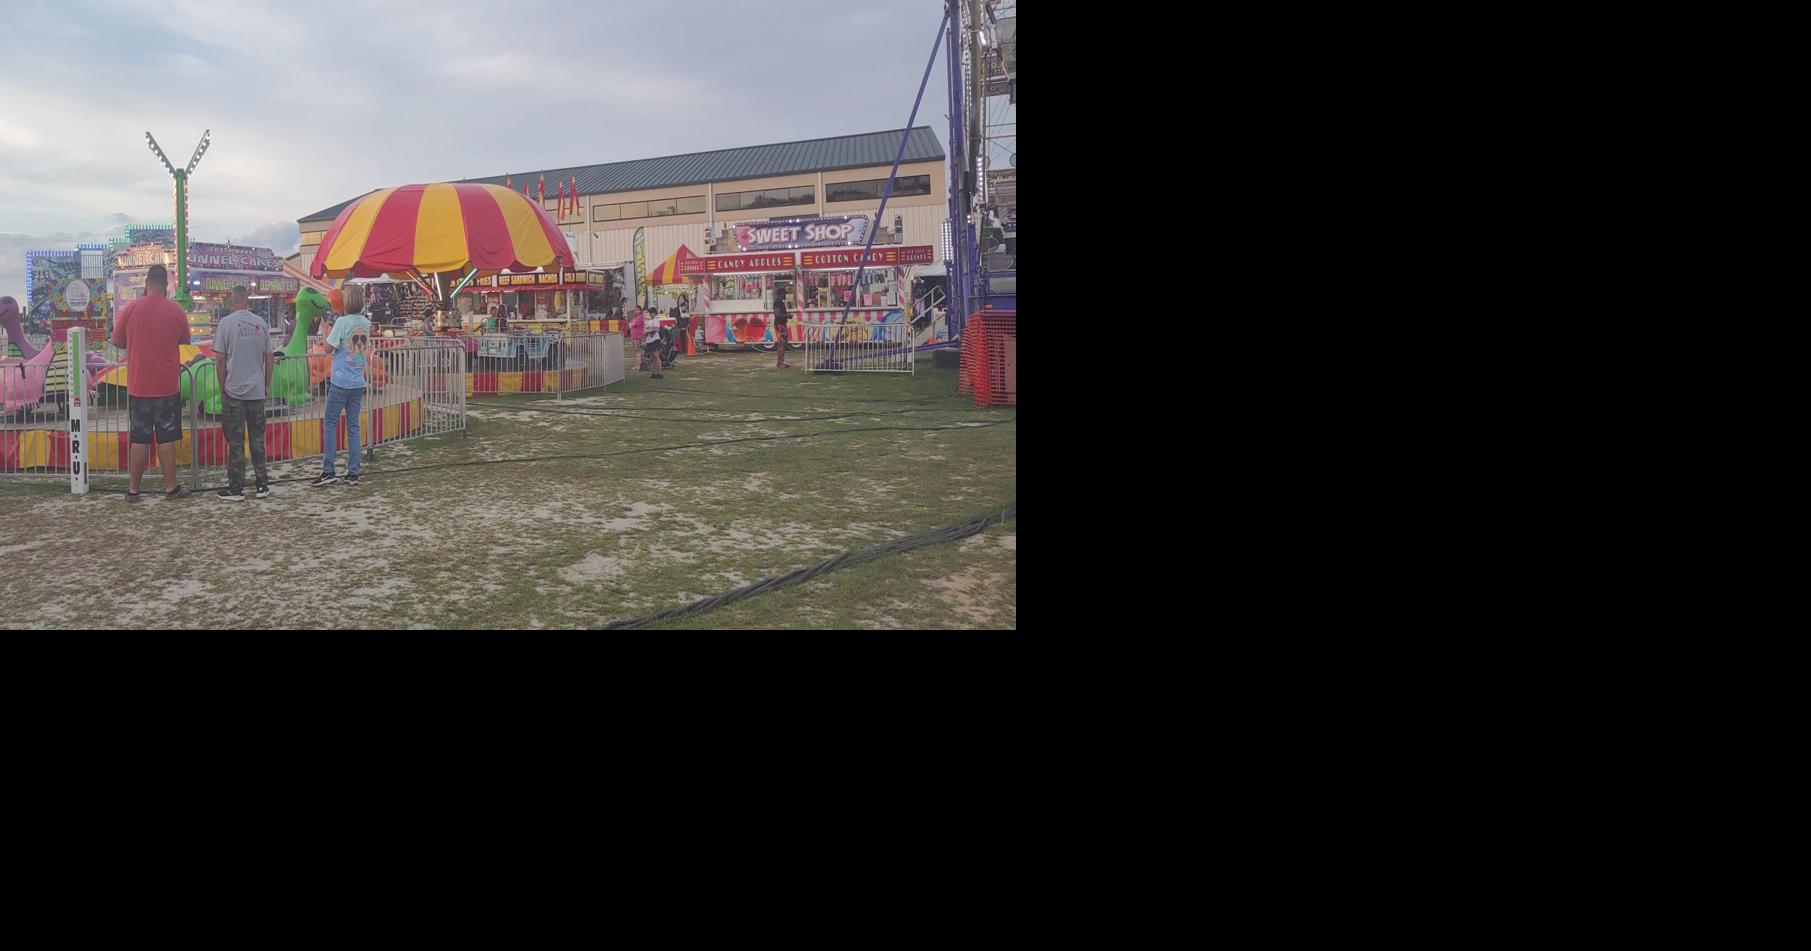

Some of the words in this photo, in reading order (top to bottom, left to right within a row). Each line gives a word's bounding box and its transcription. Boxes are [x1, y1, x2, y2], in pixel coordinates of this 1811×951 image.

[747, 226, 801, 243] SWEET
[804, 223, 854, 240] SHOP
[189, 253, 235, 265] UNNEL
[239, 256, 282, 267] CAKES
[718, 259, 745, 269] CANDY
[748, 257, 781, 267] APPLES
[815, 254, 849, 264] COTTON
[498, 275, 510, 286] BEEF
[511, 274, 536, 285] SANDWICH
[538, 273, 558, 284] NACHOS
